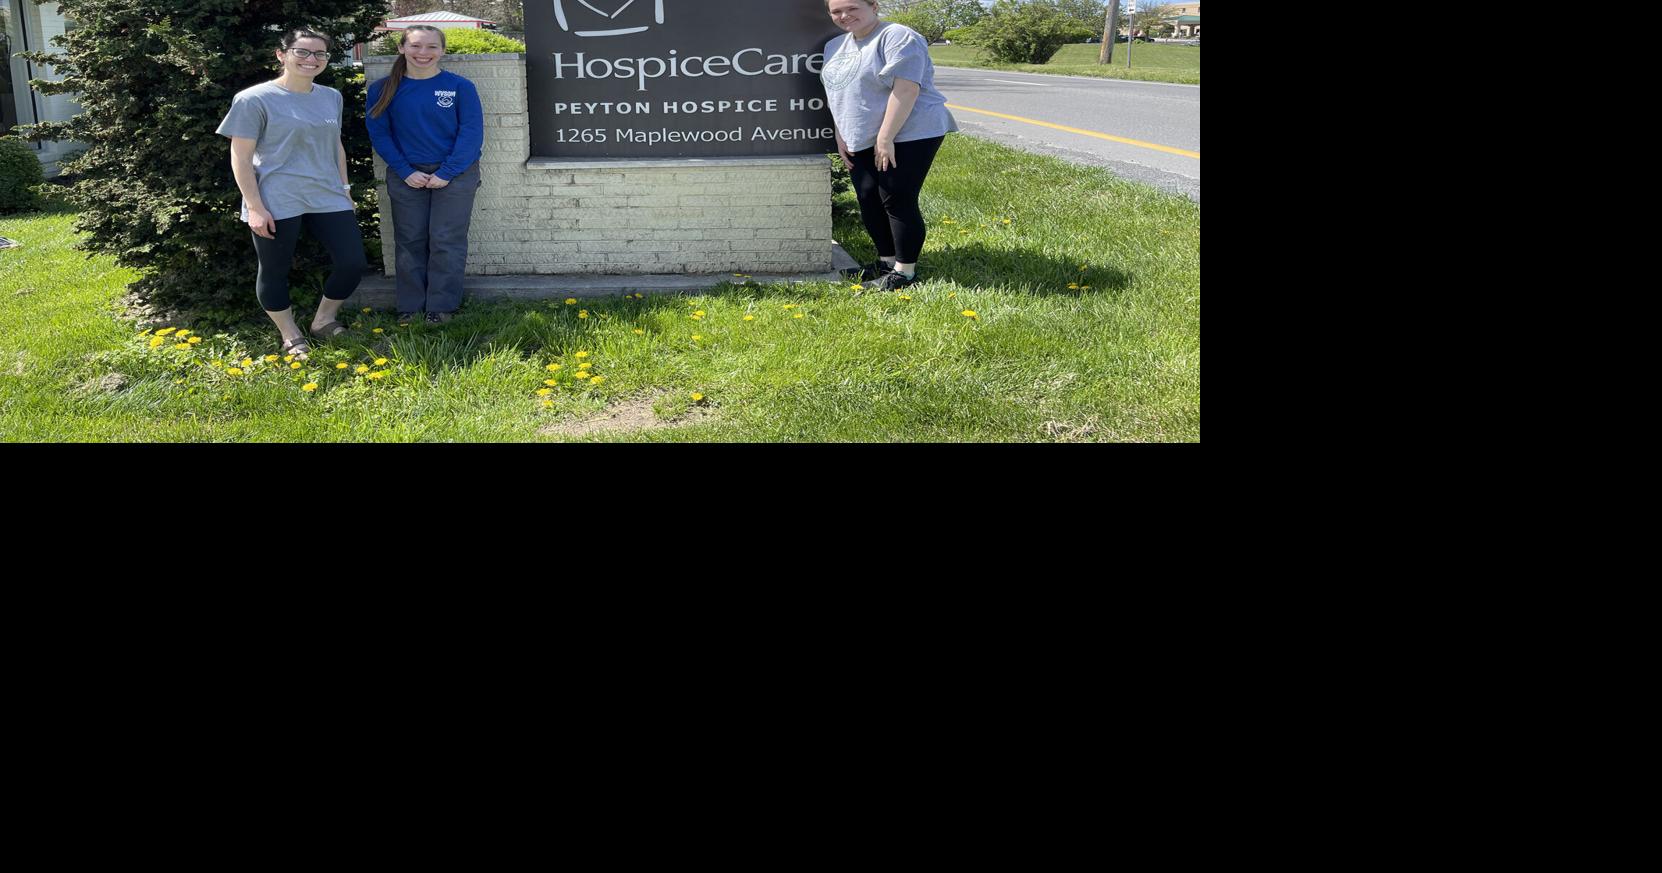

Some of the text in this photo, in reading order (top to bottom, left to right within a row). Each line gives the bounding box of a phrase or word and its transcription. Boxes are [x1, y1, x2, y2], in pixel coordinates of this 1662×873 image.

[553, 48, 823, 91] HospiceCare
[554, 97, 829, 115] PEYTON HOSPICE HO
[556, 126, 834, 146] 1265 Maplewood Avenue
